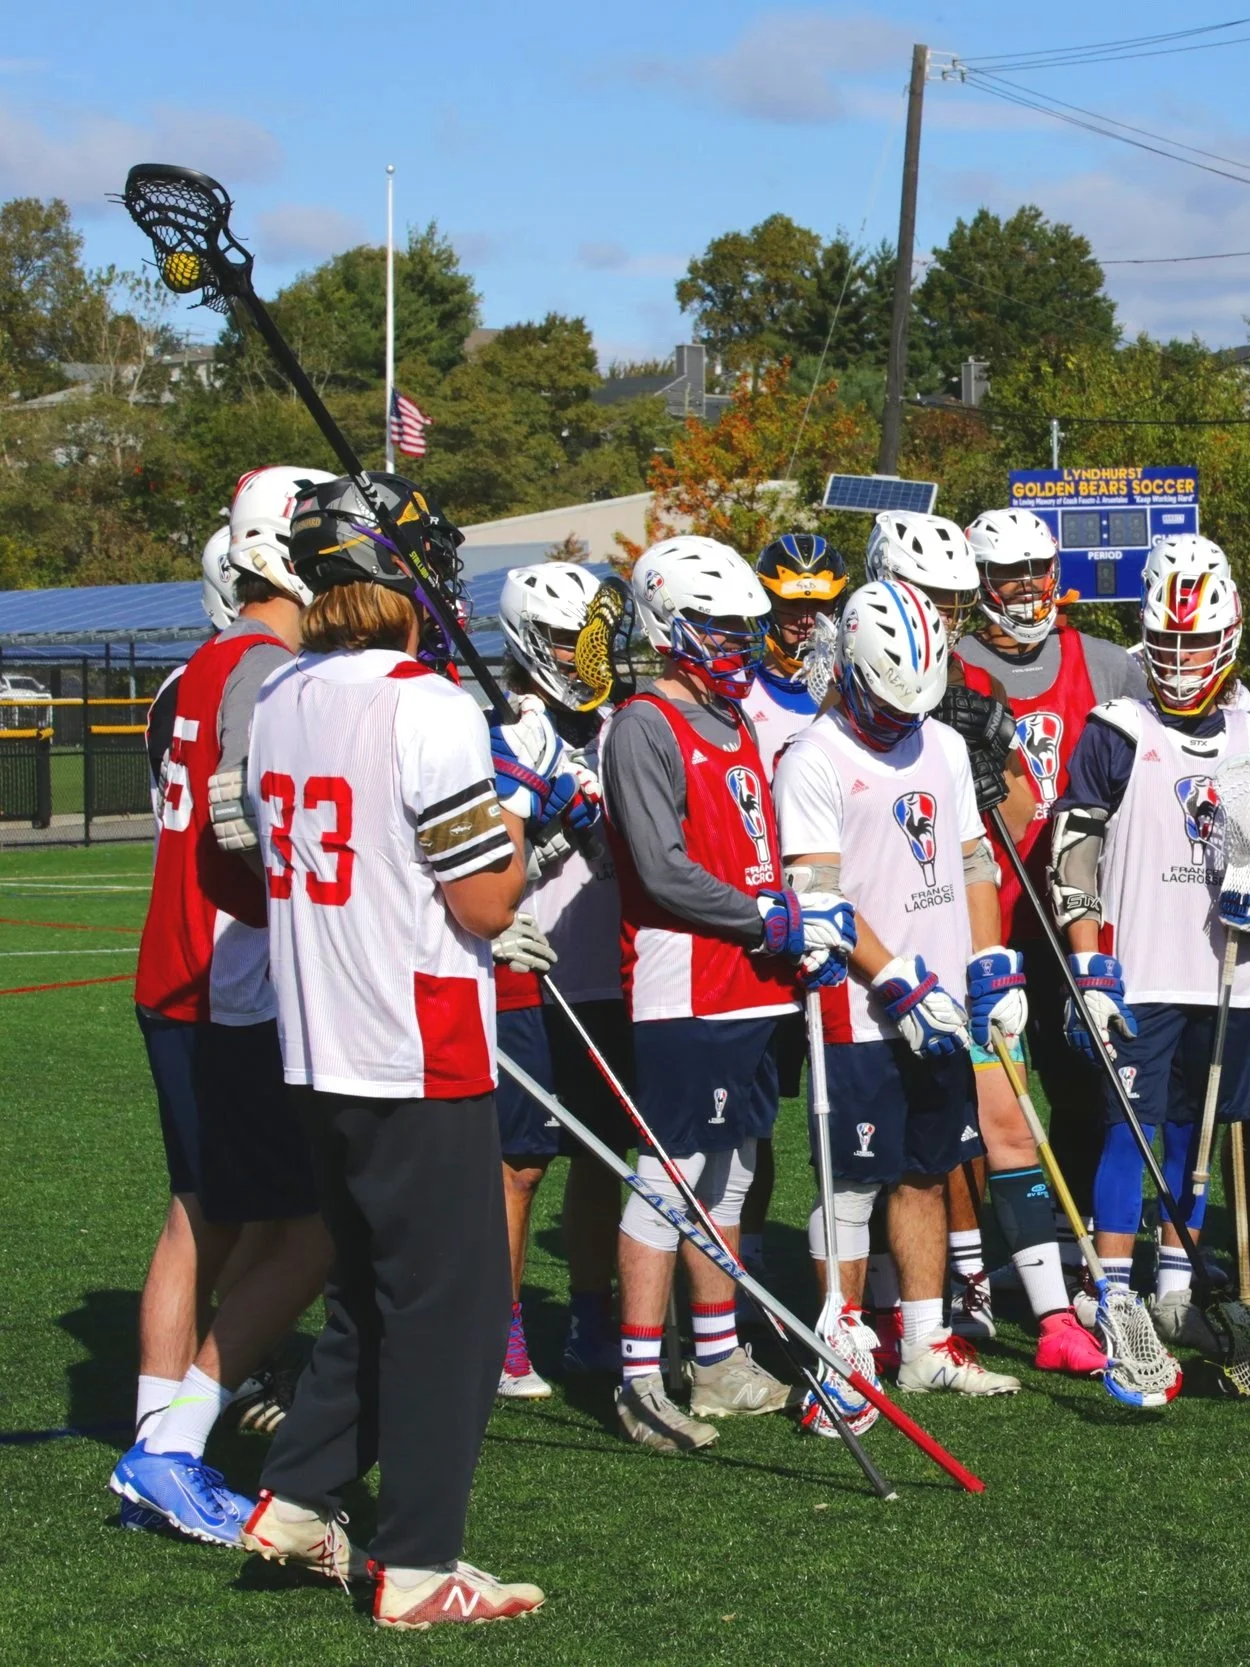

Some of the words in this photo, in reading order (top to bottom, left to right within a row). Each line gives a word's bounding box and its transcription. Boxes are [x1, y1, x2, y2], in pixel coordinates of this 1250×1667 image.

[1063, 468, 1143, 481] LYNDHURST
[1012, 482, 1075, 497] GOLDEN
[1079, 480, 1128, 496] BEARS
[1132, 479, 1196, 495] SOCCER
[1087, 551, 1123, 560] PERIOD
[1189, 739, 1208, 747] STX
[260, 771, 355, 906] 33
[625, 1174, 748, 1279] EASTON
